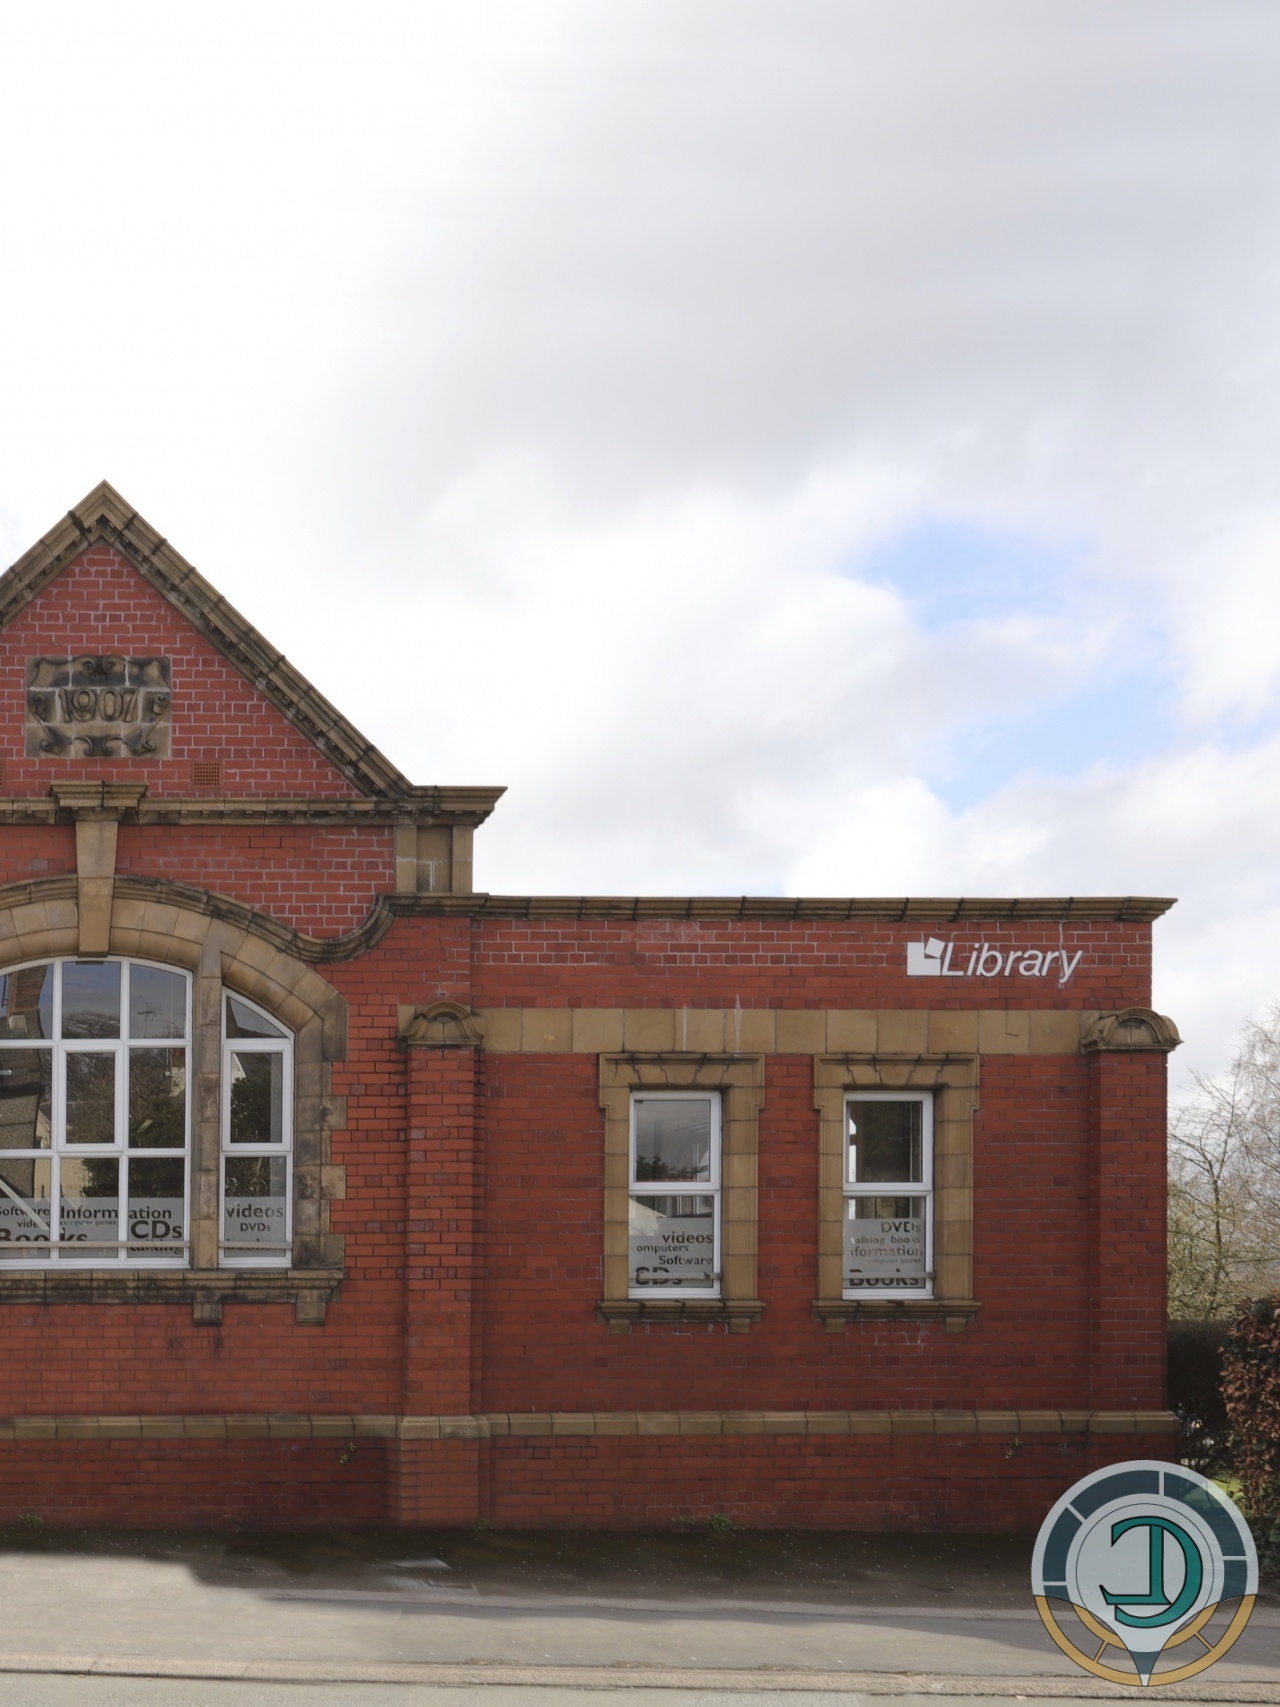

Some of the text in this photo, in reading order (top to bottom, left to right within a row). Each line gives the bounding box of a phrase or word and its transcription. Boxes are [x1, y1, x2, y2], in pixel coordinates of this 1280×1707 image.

[58, 688, 139, 722] 1907
[941, 942, 1082, 983] Library
[225, 1203, 284, 1218] videos
[17, 1219, 50, 1228] vide
[130, 1220, 182, 1239] CDs
[240, 1222, 271, 1232] DVDs
[881, 1221, 921, 1233] DVDs
[662, 1231, 713, 1244] videos
[632, 1245, 689, 1254] omputers
[849, 1246, 923, 1257] nformation
[658, 1255, 713, 1265] Software
